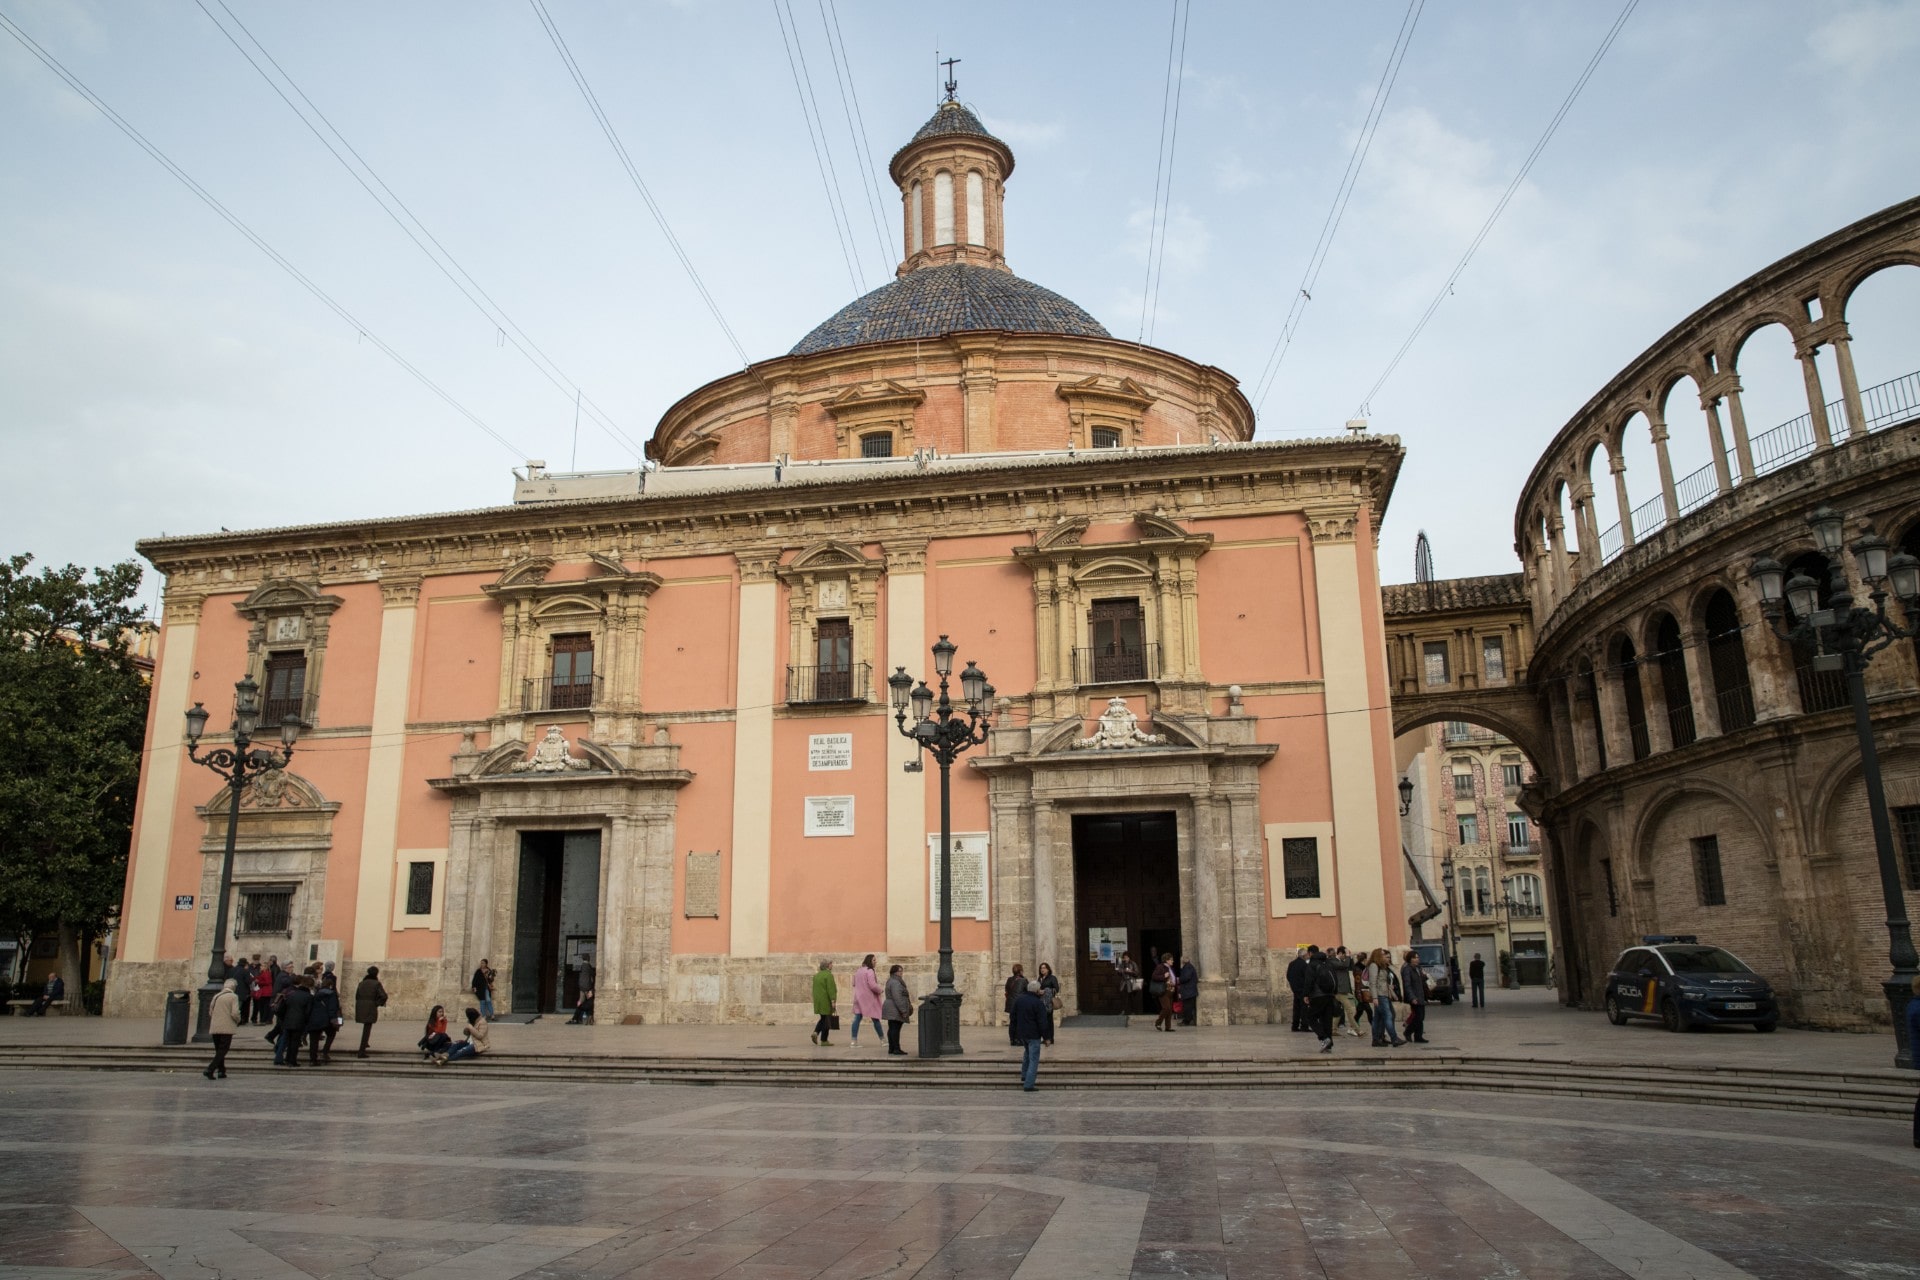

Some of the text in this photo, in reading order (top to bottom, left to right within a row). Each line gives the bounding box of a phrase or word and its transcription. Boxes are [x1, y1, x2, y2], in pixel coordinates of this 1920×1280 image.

[813, 737, 825, 745] REAL
[812, 759, 848, 767] DESAMPARADOS
[1617, 987, 1643, 998] POLICIA
